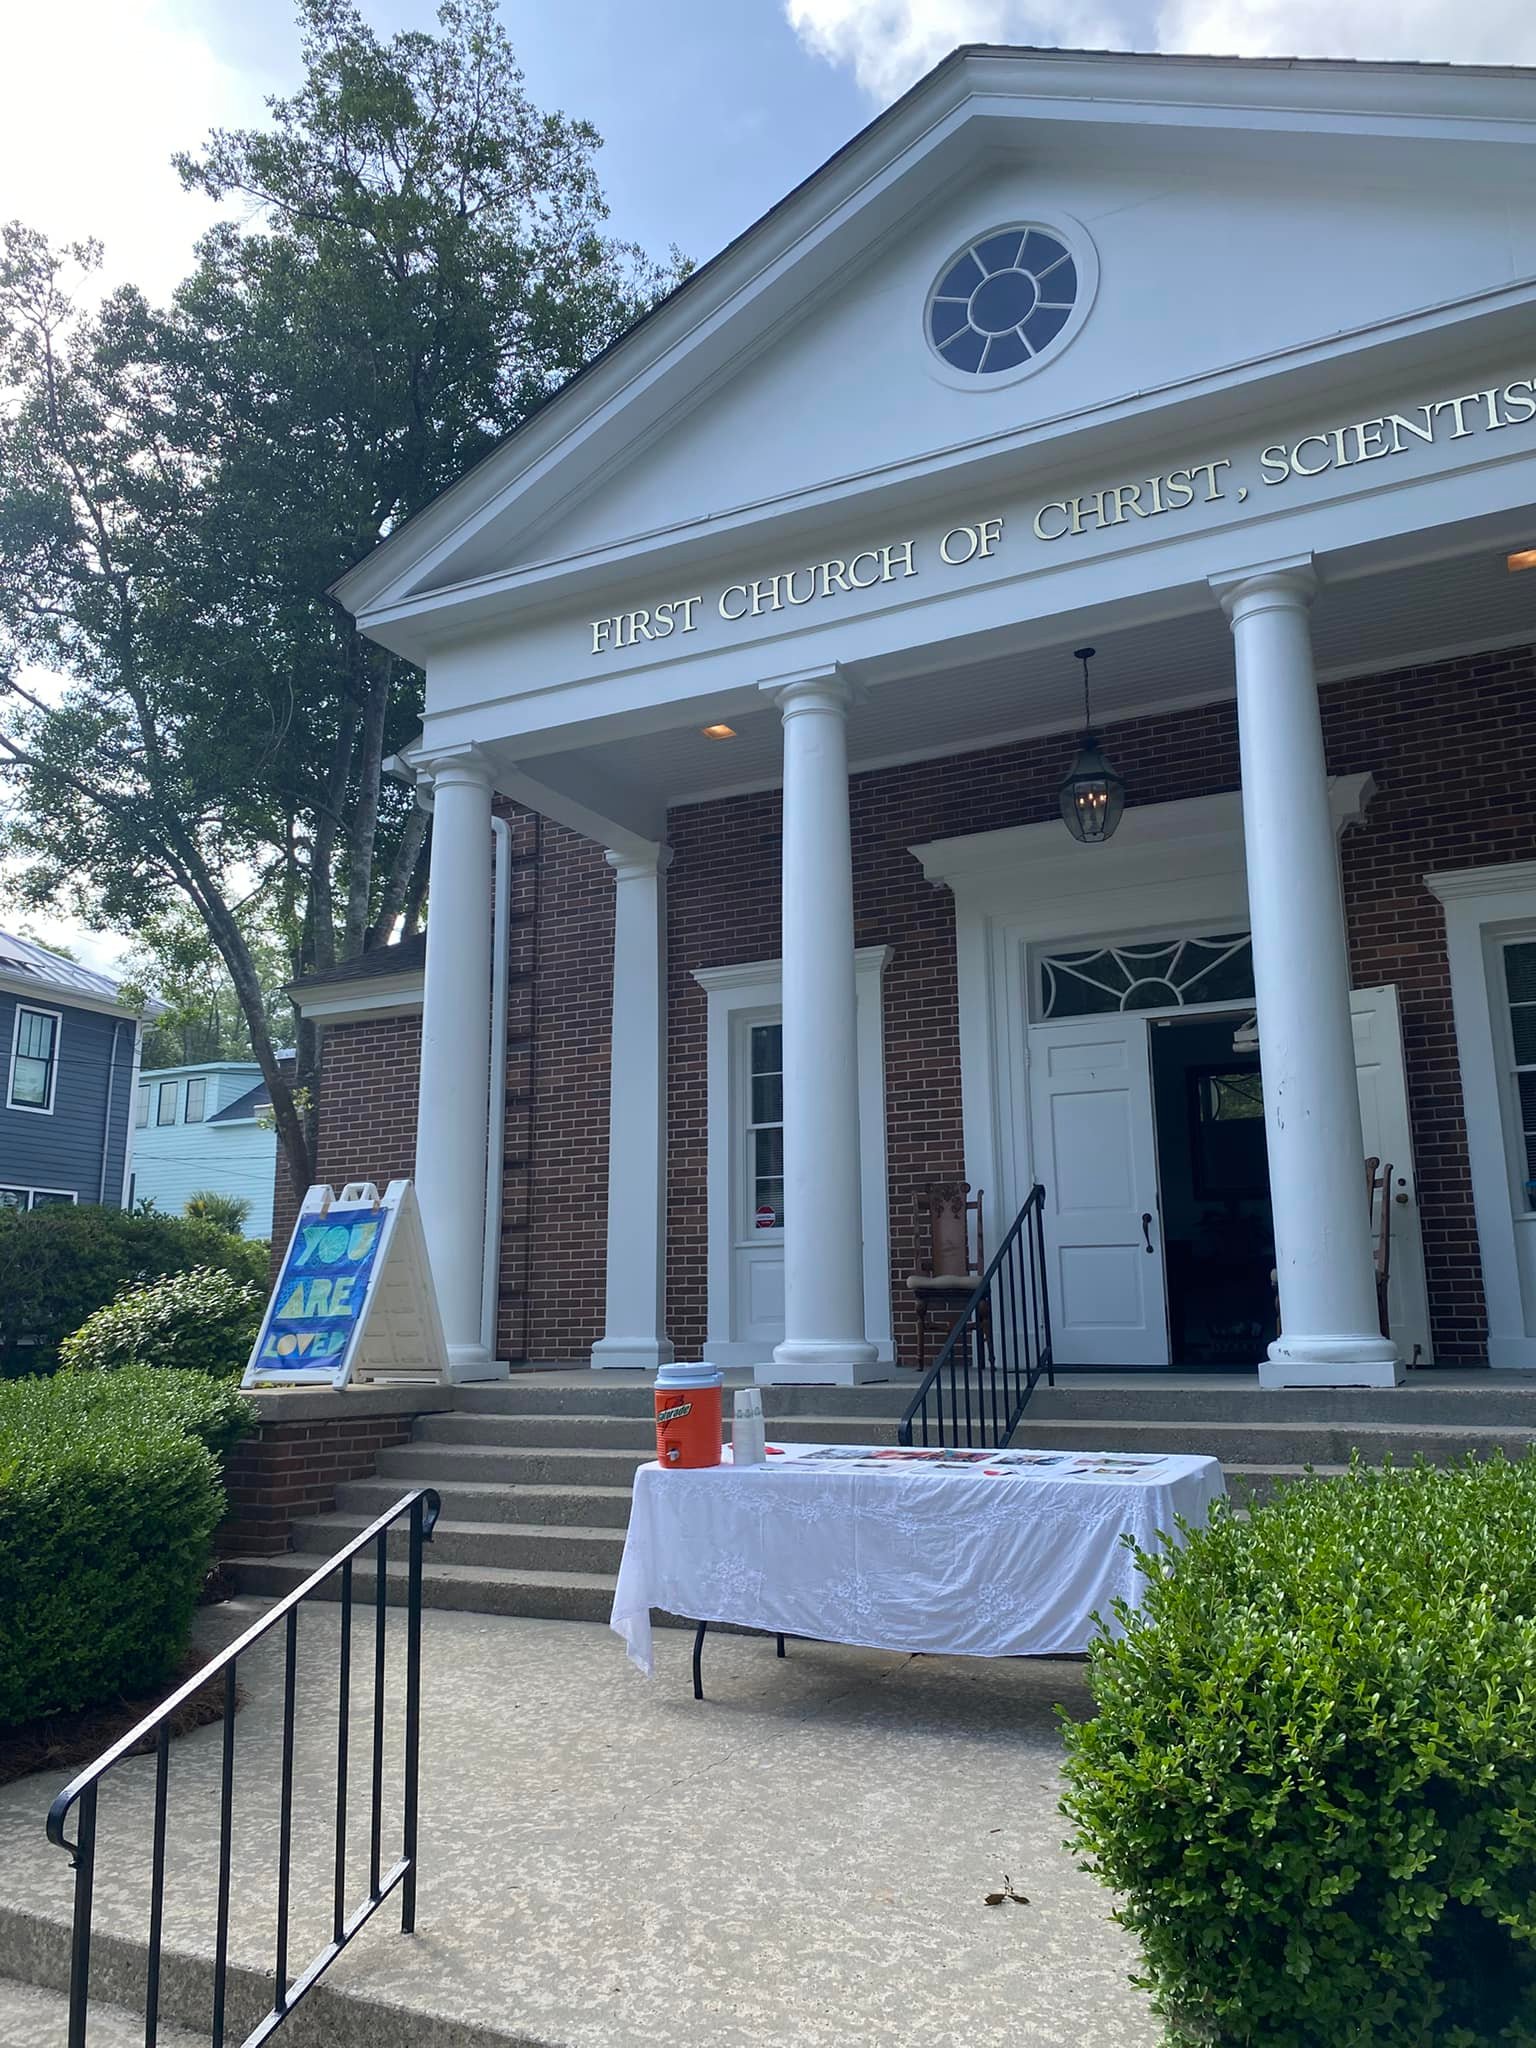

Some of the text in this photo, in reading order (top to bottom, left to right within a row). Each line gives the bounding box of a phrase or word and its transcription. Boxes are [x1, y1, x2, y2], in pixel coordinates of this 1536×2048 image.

[590, 379, 1536, 655] FIRST CHURCH OF CHRIST, SCIENTIS
[294, 1221, 379, 1266] YOU
[277, 1277, 355, 1319] ARE
[263, 1331, 346, 1358] LOVED
